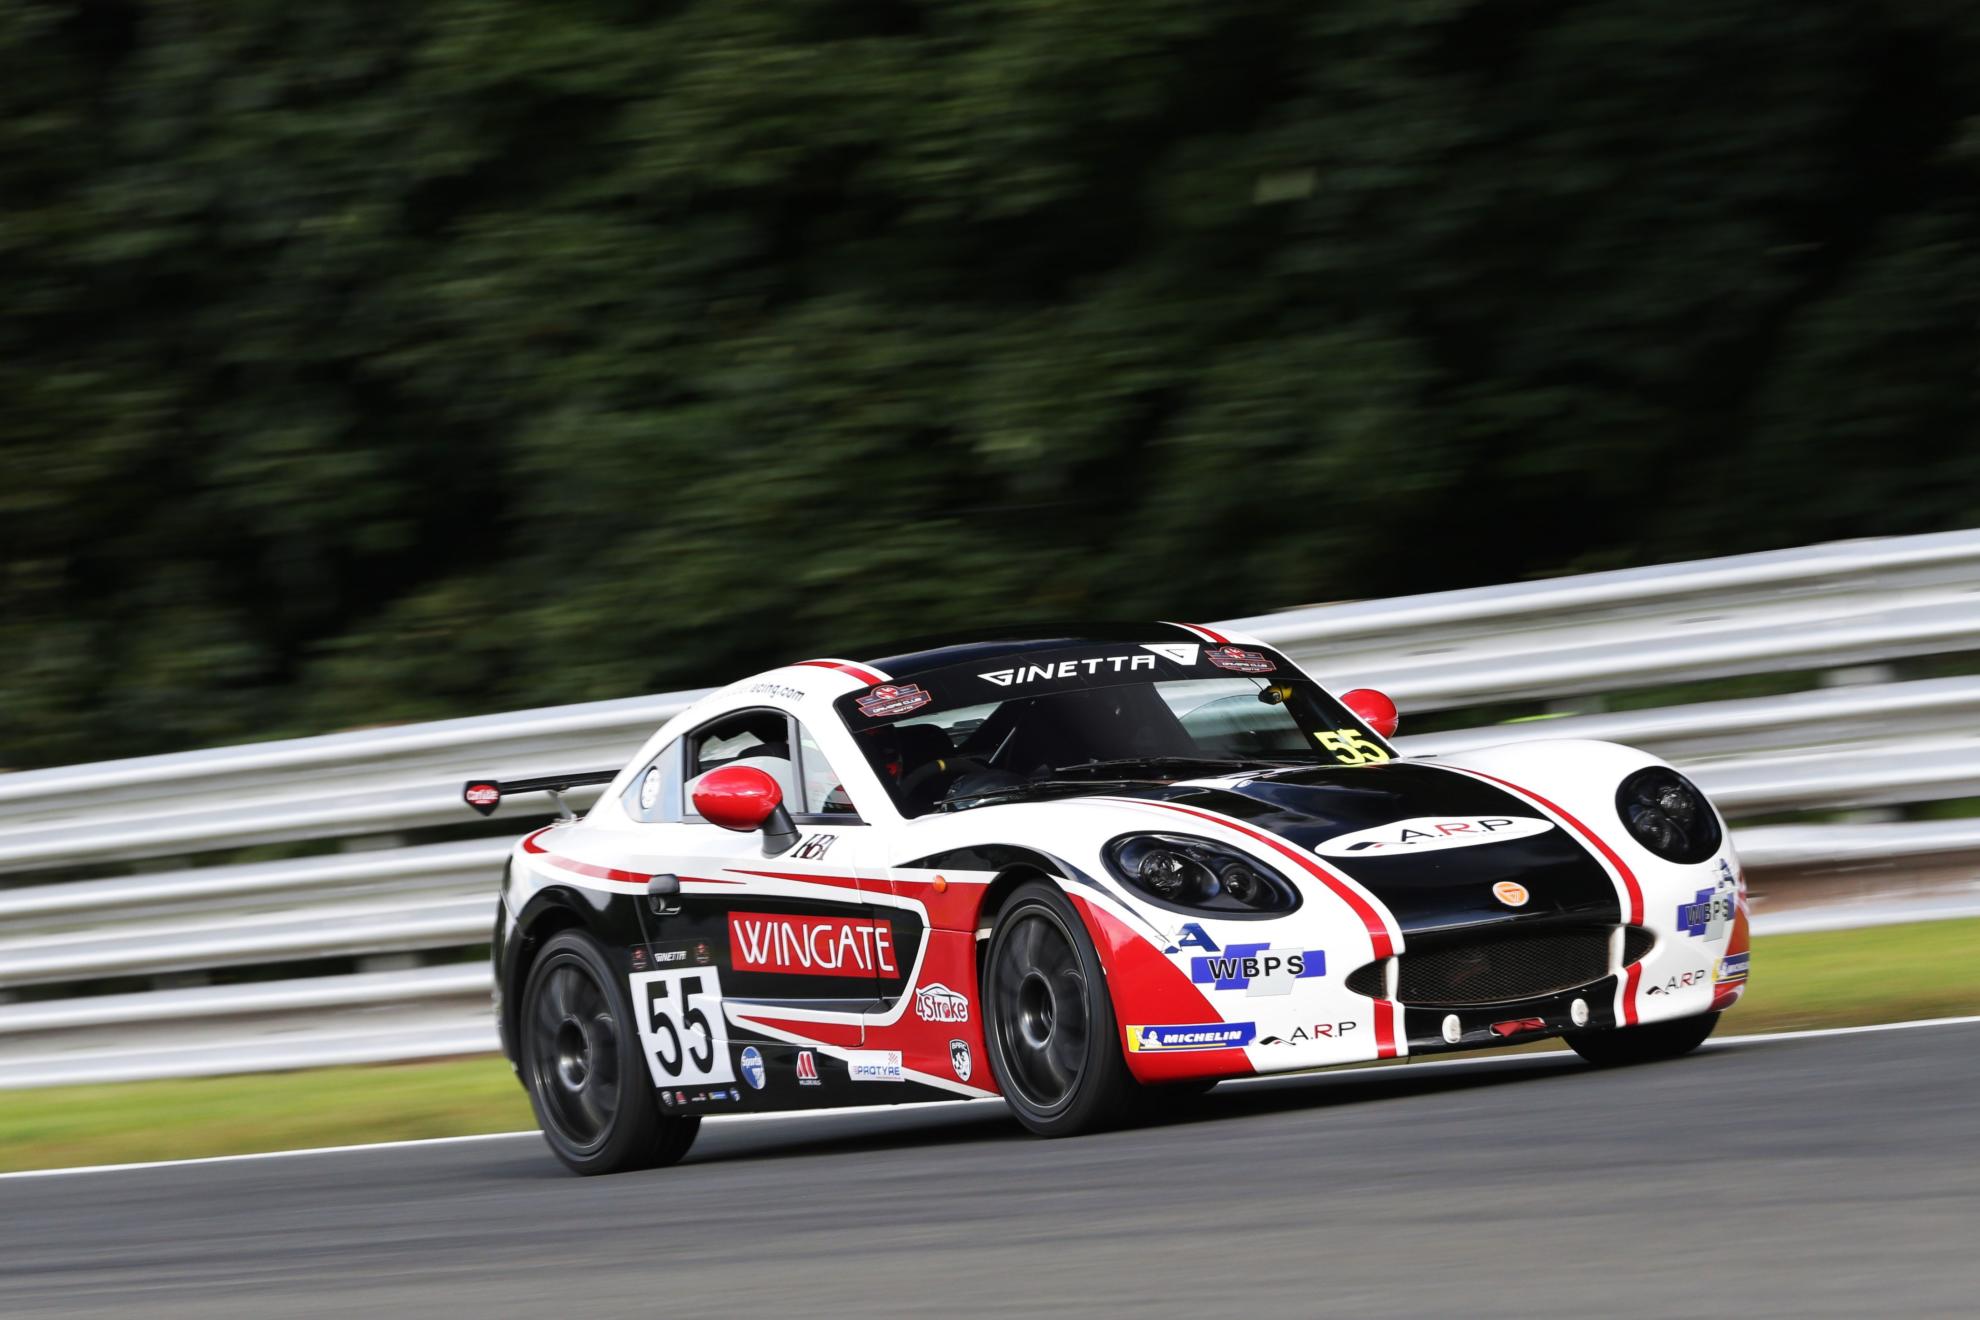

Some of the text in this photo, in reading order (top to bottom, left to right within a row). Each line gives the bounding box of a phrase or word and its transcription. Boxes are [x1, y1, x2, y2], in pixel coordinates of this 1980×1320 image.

[977, 655, 1156, 687] GINETTA
[1313, 728, 1390, 764] 55
[1685, 899, 1730, 926] WBPS
[733, 919, 895, 972] WINGATE
[1209, 955, 1305, 981] WBPS
[646, 975, 714, 1078] 55
[1163, 1030, 1243, 1045] MICHELIN
[856, 1065, 901, 1076] PROTYRE
